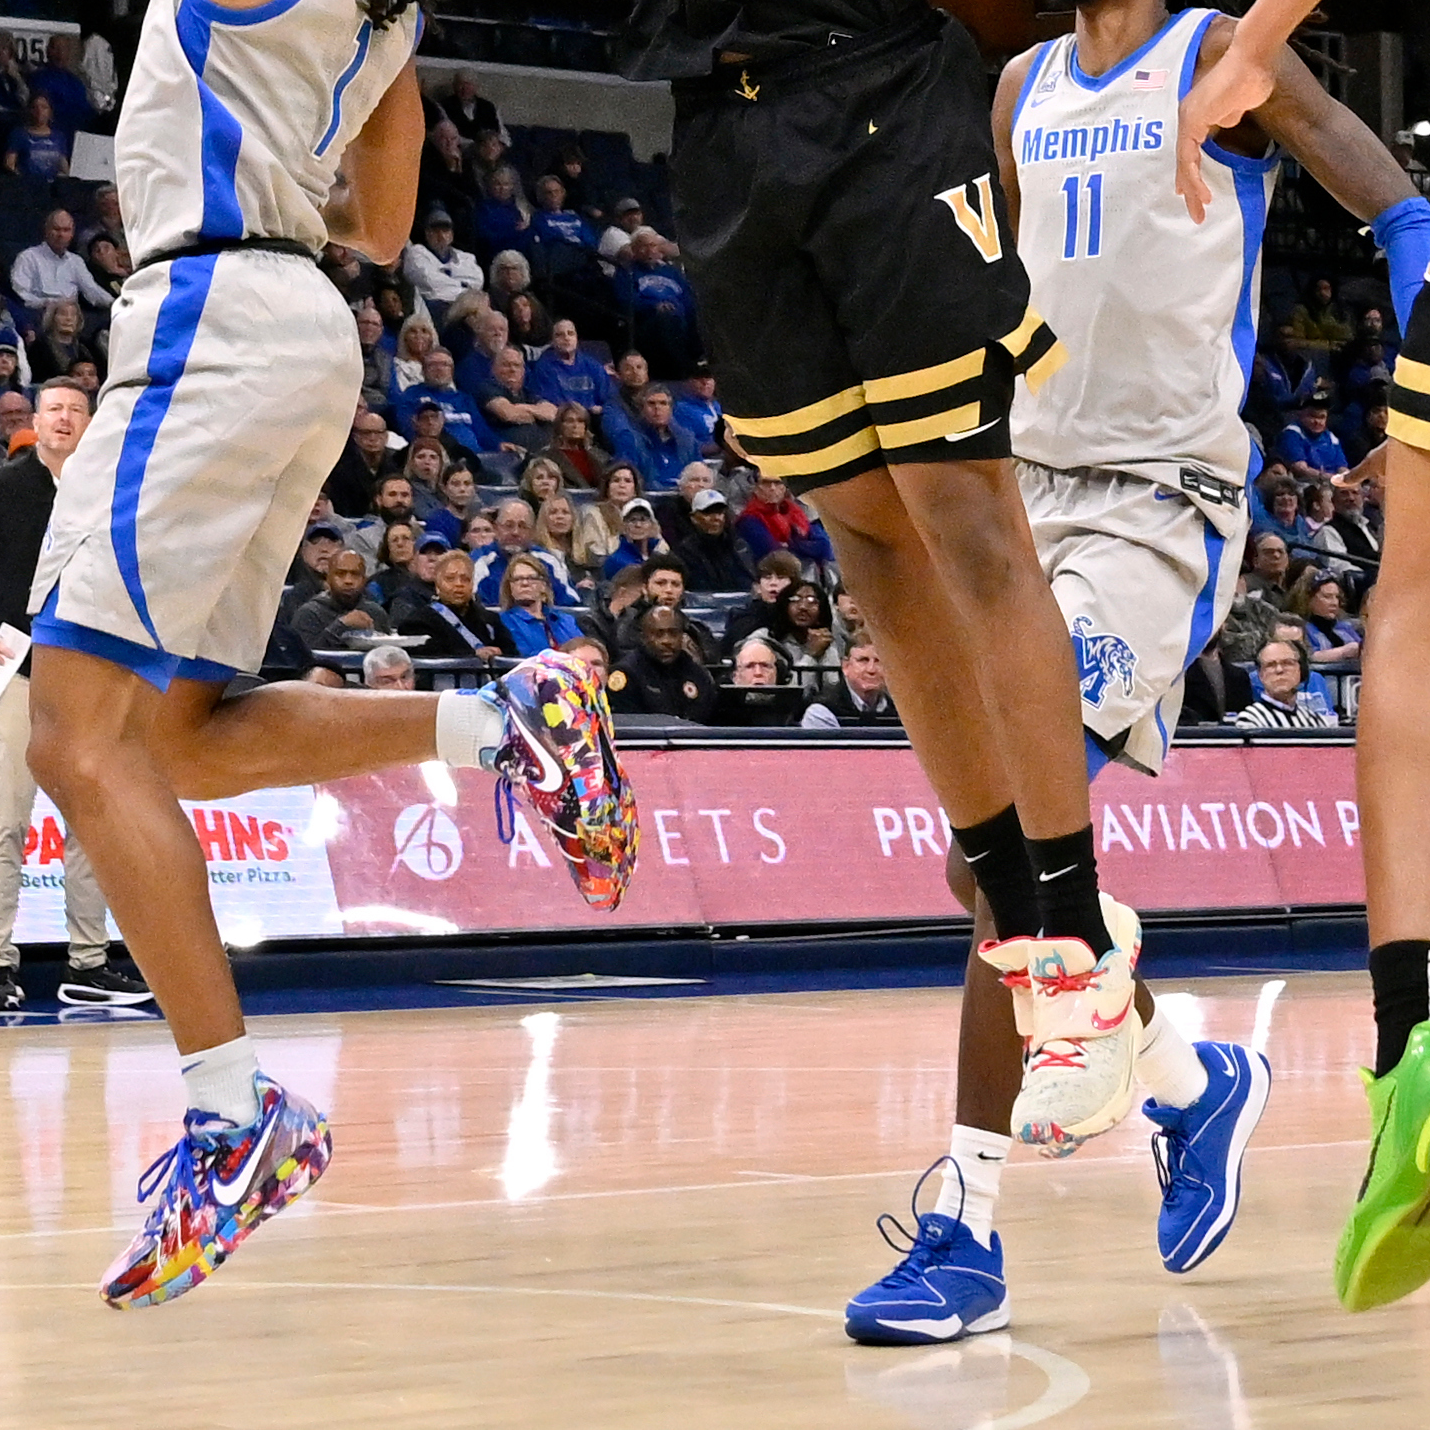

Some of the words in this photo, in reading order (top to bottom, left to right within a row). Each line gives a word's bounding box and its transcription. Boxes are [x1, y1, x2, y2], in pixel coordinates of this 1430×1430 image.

[1020, 116, 1165, 167] Memphis
[1061, 172, 1104, 261] 11
[21, 816, 66, 865] PA
[192, 808, 290, 862] HNS
[653, 808, 787, 865] ETS
[1101, 801, 1326, 852] AVIATION
[210, 869, 243, 884] tter
